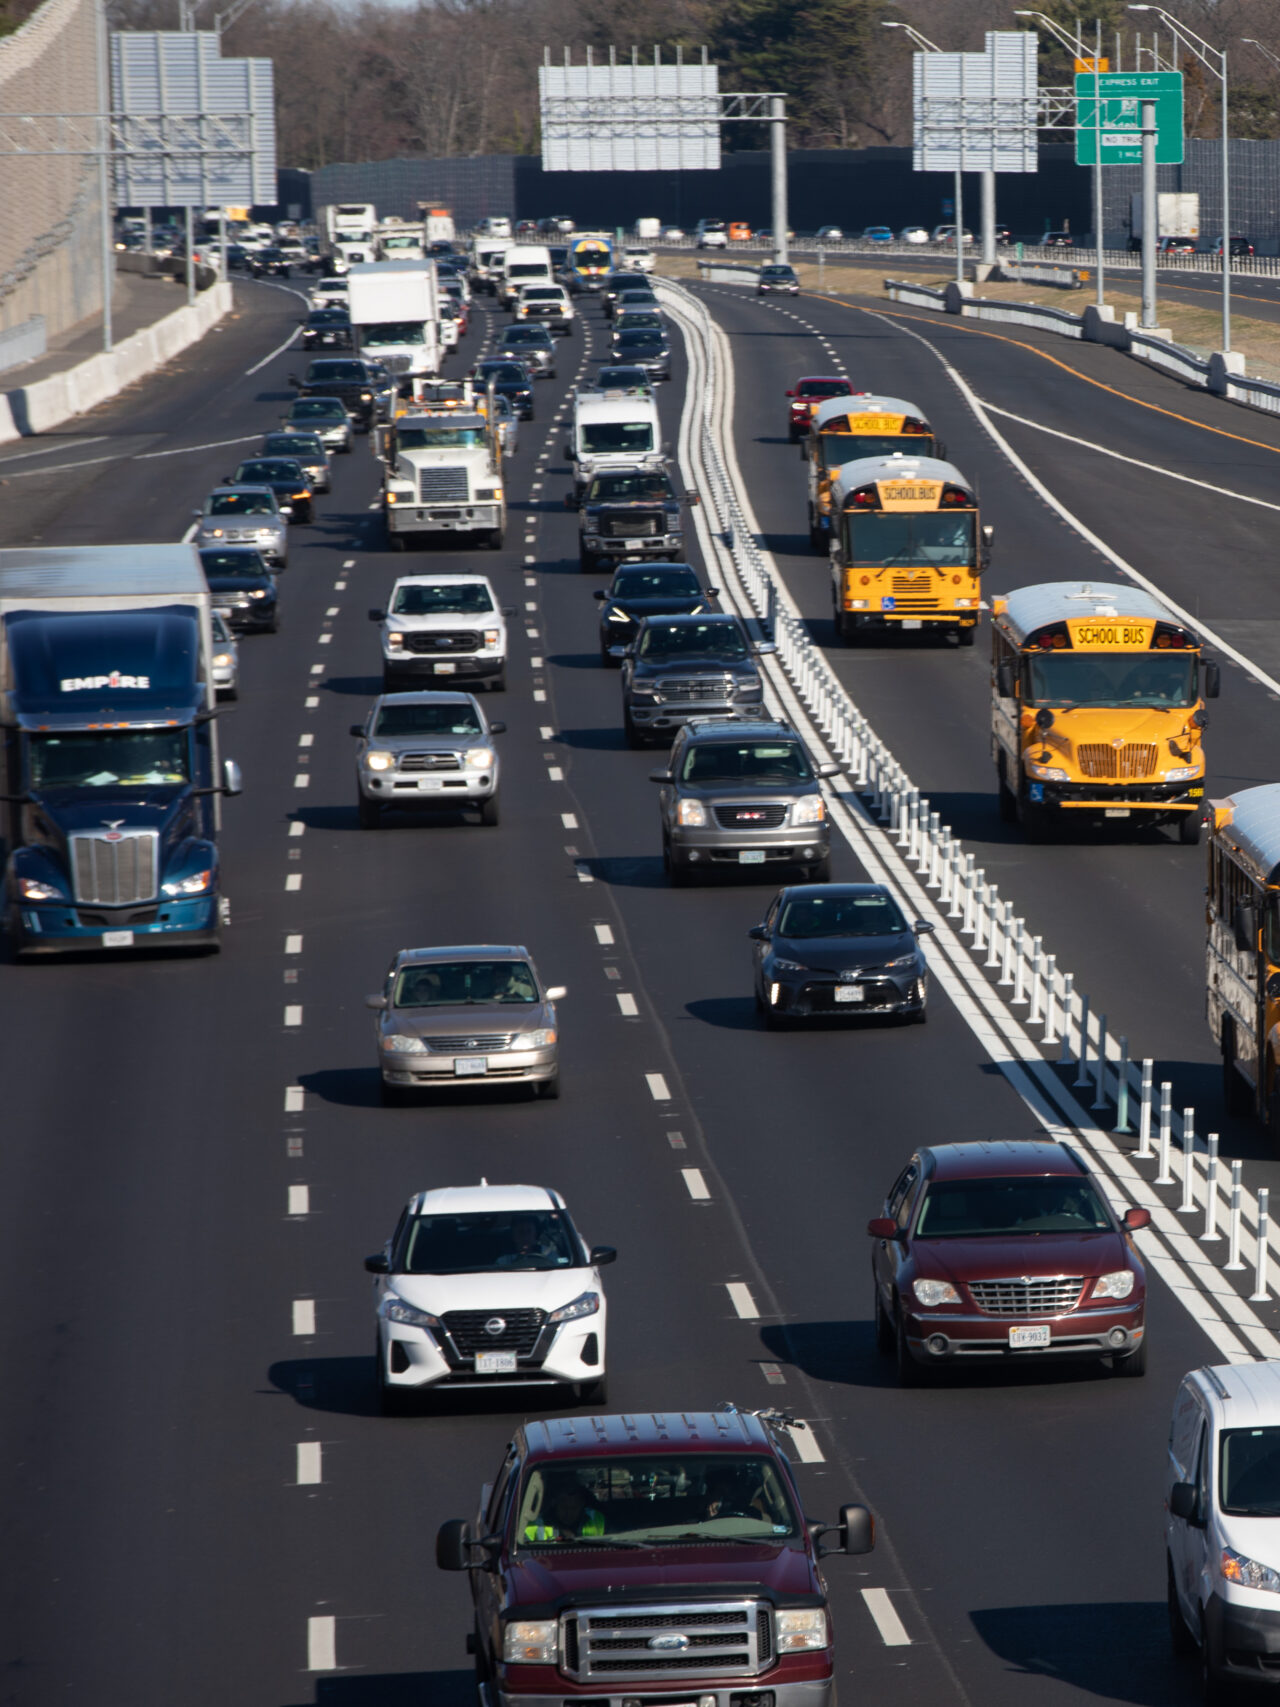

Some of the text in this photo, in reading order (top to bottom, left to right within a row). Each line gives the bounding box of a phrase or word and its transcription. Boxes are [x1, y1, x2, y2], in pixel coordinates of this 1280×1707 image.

[1141, 78, 1159, 86] EXIT
[884, 487, 936, 500] SCHOOL BUS
[1078, 628, 1144, 644] SCHOOL BUS
